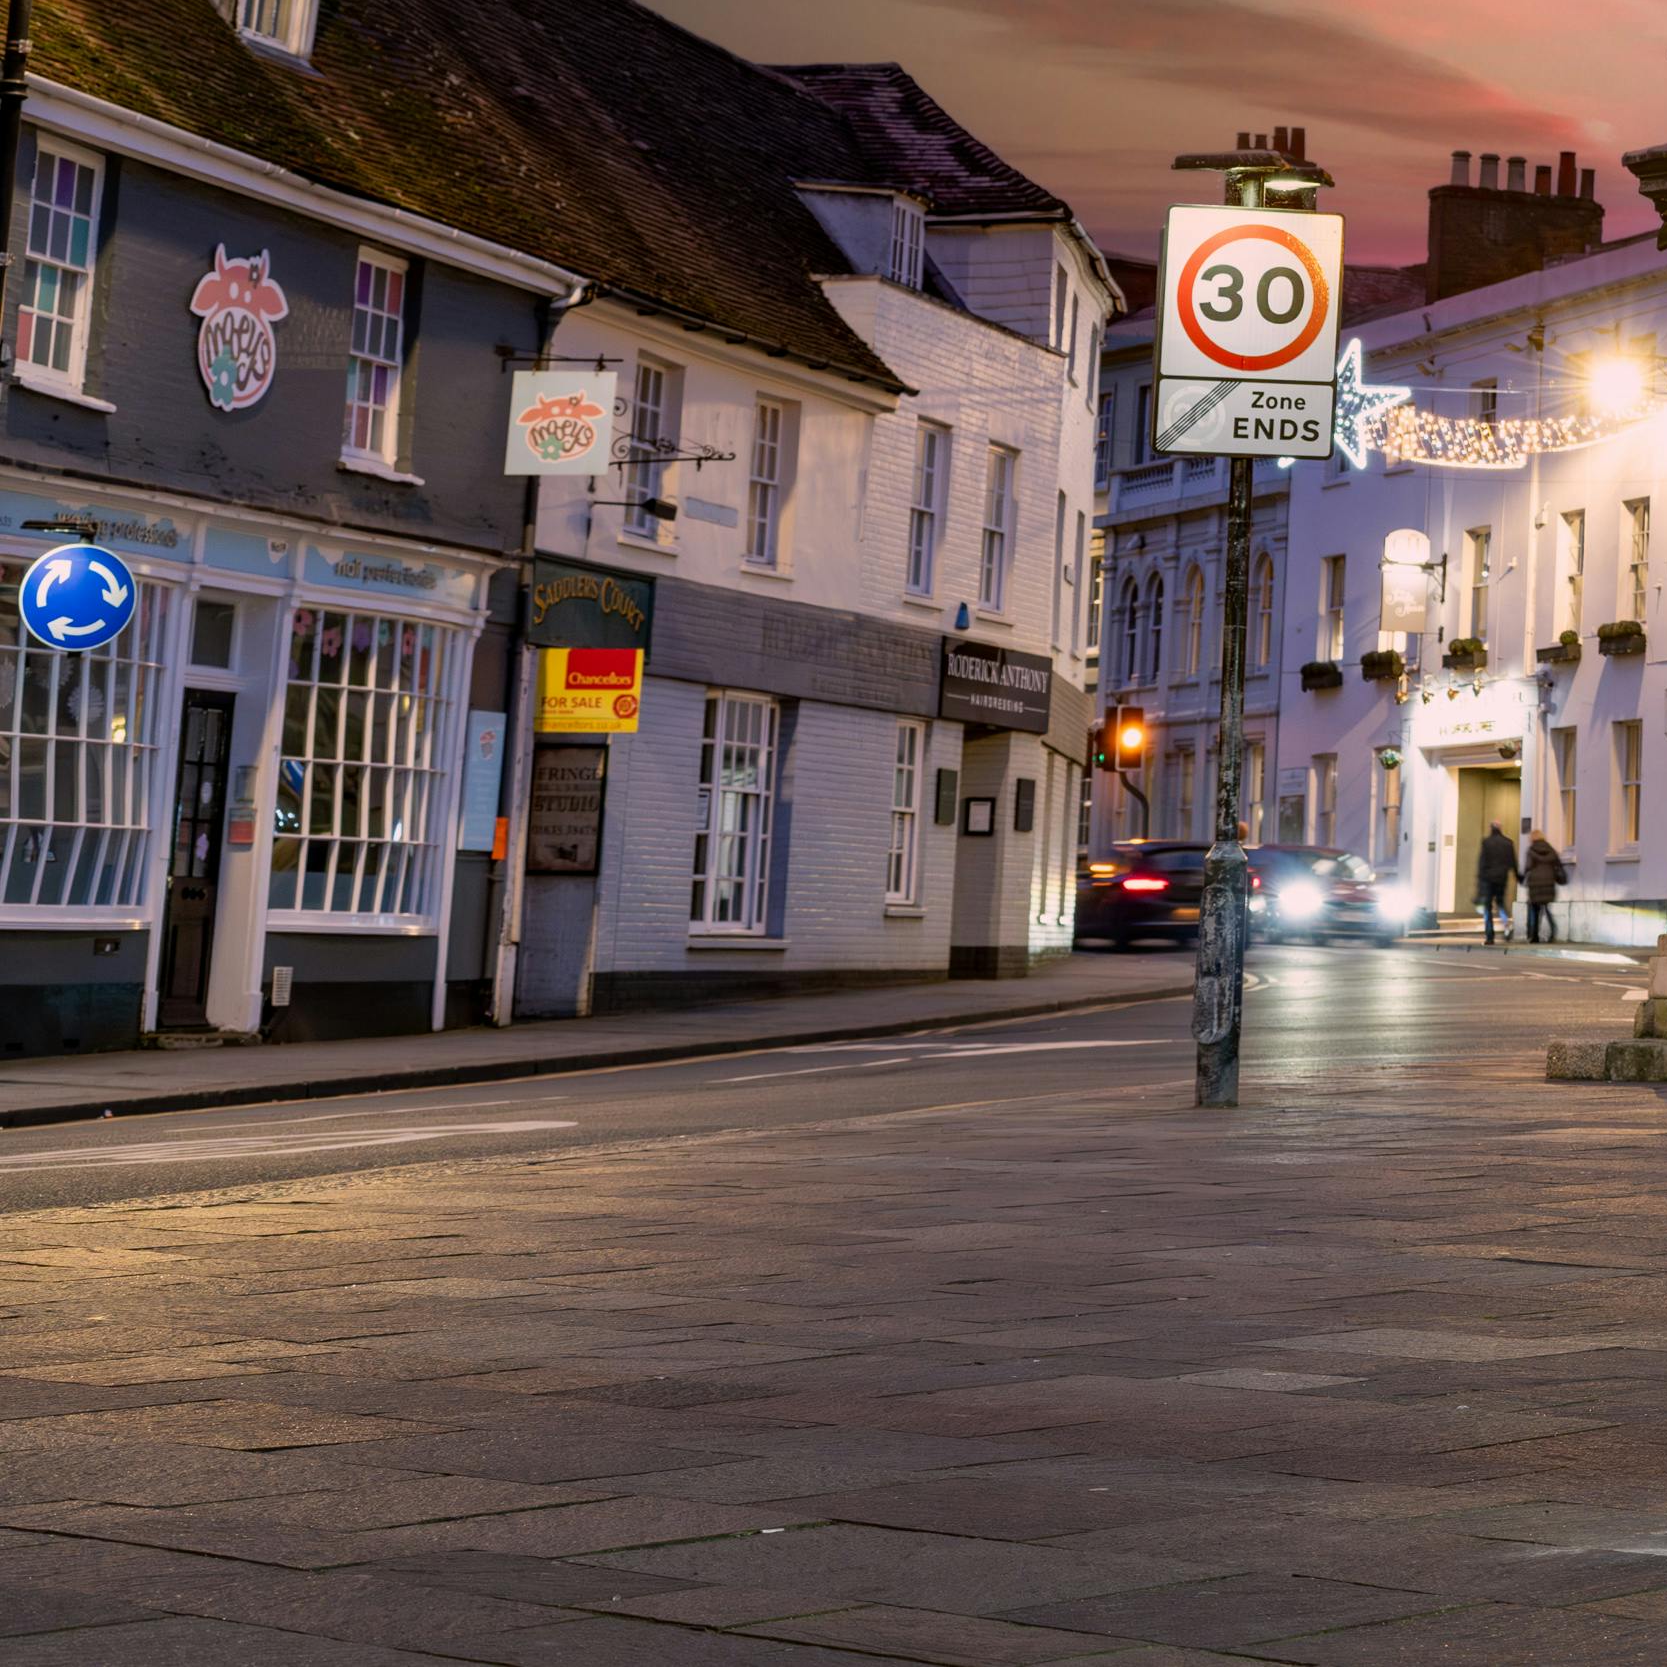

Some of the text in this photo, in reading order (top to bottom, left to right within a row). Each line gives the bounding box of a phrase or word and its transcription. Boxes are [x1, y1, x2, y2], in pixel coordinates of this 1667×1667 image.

[1199, 264, 1305, 324] 30
[1251, 391, 1307, 411] Zone
[1233, 417, 1320, 442] ENDS
[568, 671, 631, 686] Chancellors
[948, 653, 1049, 694] RODERICK ANTHONY
[541, 697, 602, 708] FOR SALE
